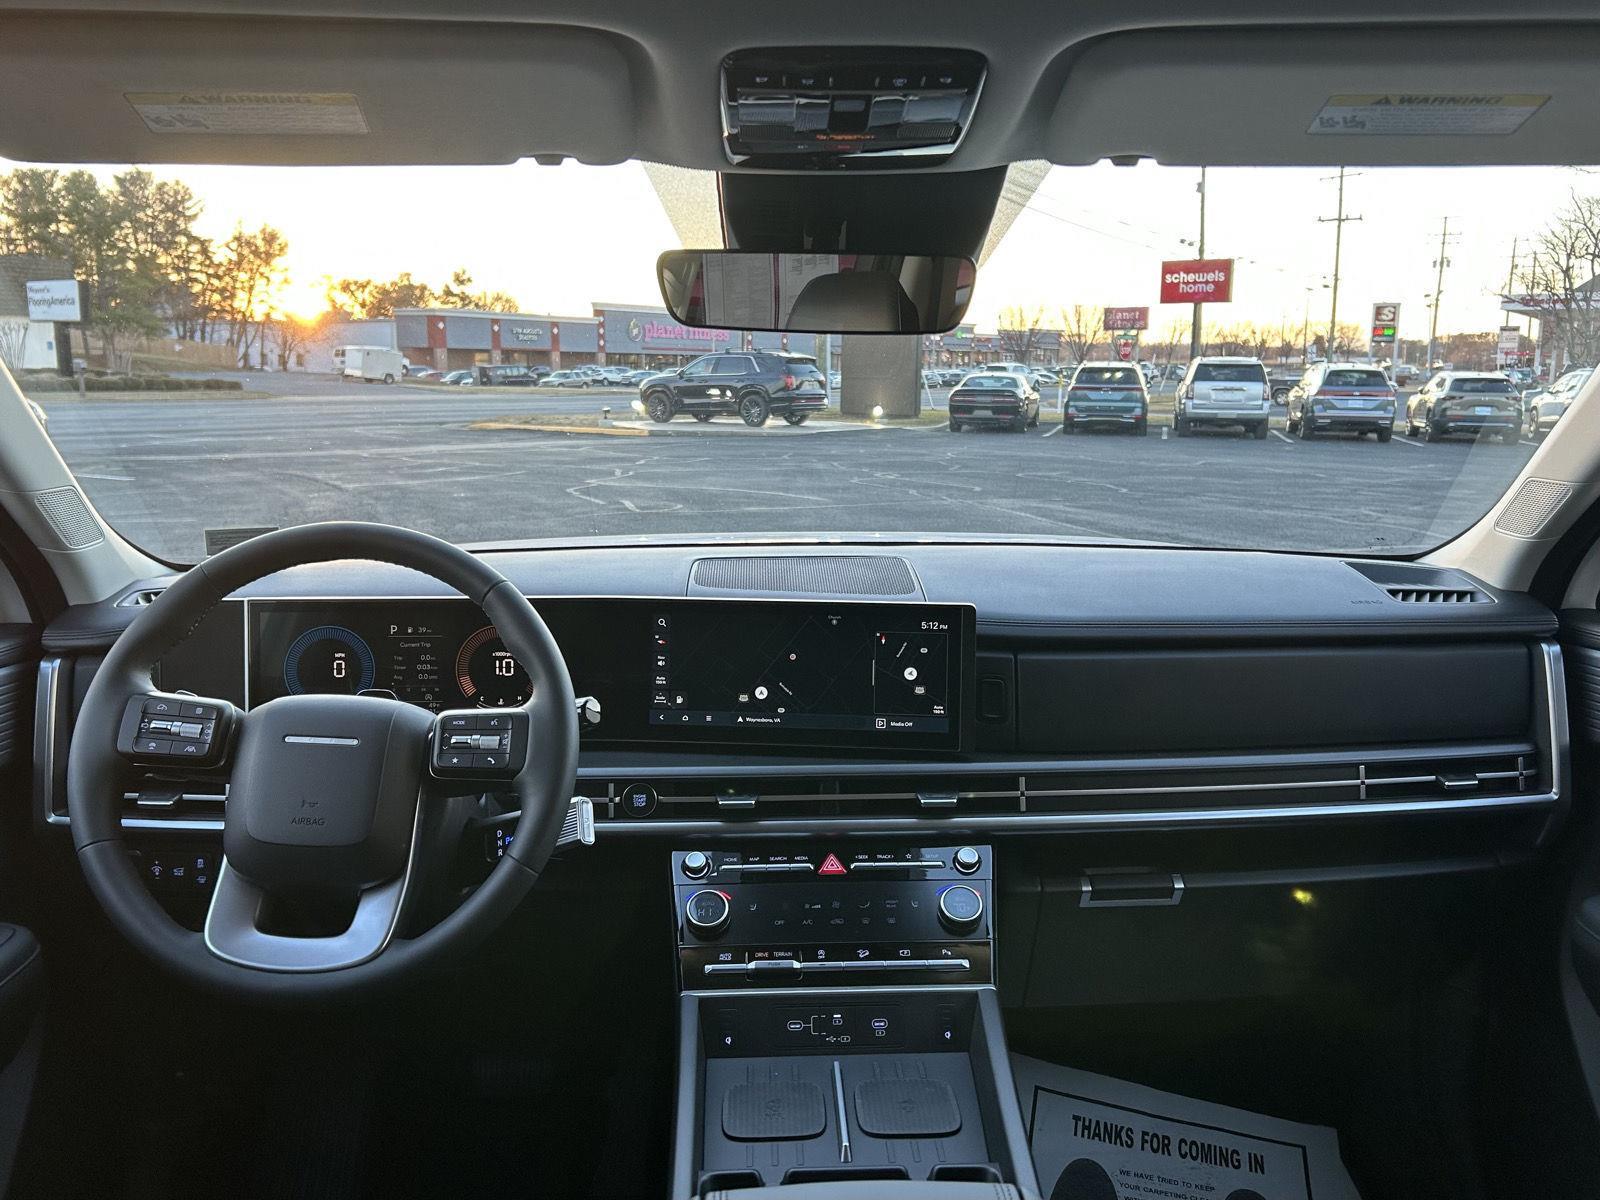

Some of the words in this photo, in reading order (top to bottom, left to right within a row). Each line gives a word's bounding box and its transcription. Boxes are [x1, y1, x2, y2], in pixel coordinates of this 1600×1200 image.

[1400, 96, 1501, 105] WARNING
[1164, 270, 1226, 284] schewels
[1179, 282, 1216, 293] home
[644, 320, 685, 341] planet
[390, 625, 398, 635] P
[921, 621, 939, 630] 5:12
[290, 817, 326, 826] AIRBAG
[497, 848, 503, 857] R
[1071, 1114, 1135, 1149] THANKS
[1140, 1130, 1172, 1157] FOR
[1178, 1138, 1241, 1170] COMING
[1247, 1151, 1266, 1176] IN
[1119, 1168, 1131, 1177] WE
[1133, 1171, 1155, 1182] HAVE
[1156, 1174, 1179, 1187] TRIED
[1181, 1180, 1193, 1189] TO
[1194, 1183, 1216, 1193] KEEP
[1119, 1182, 1142, 1193] YOUR
[1143, 1187, 1189, 1200] CARPETING
